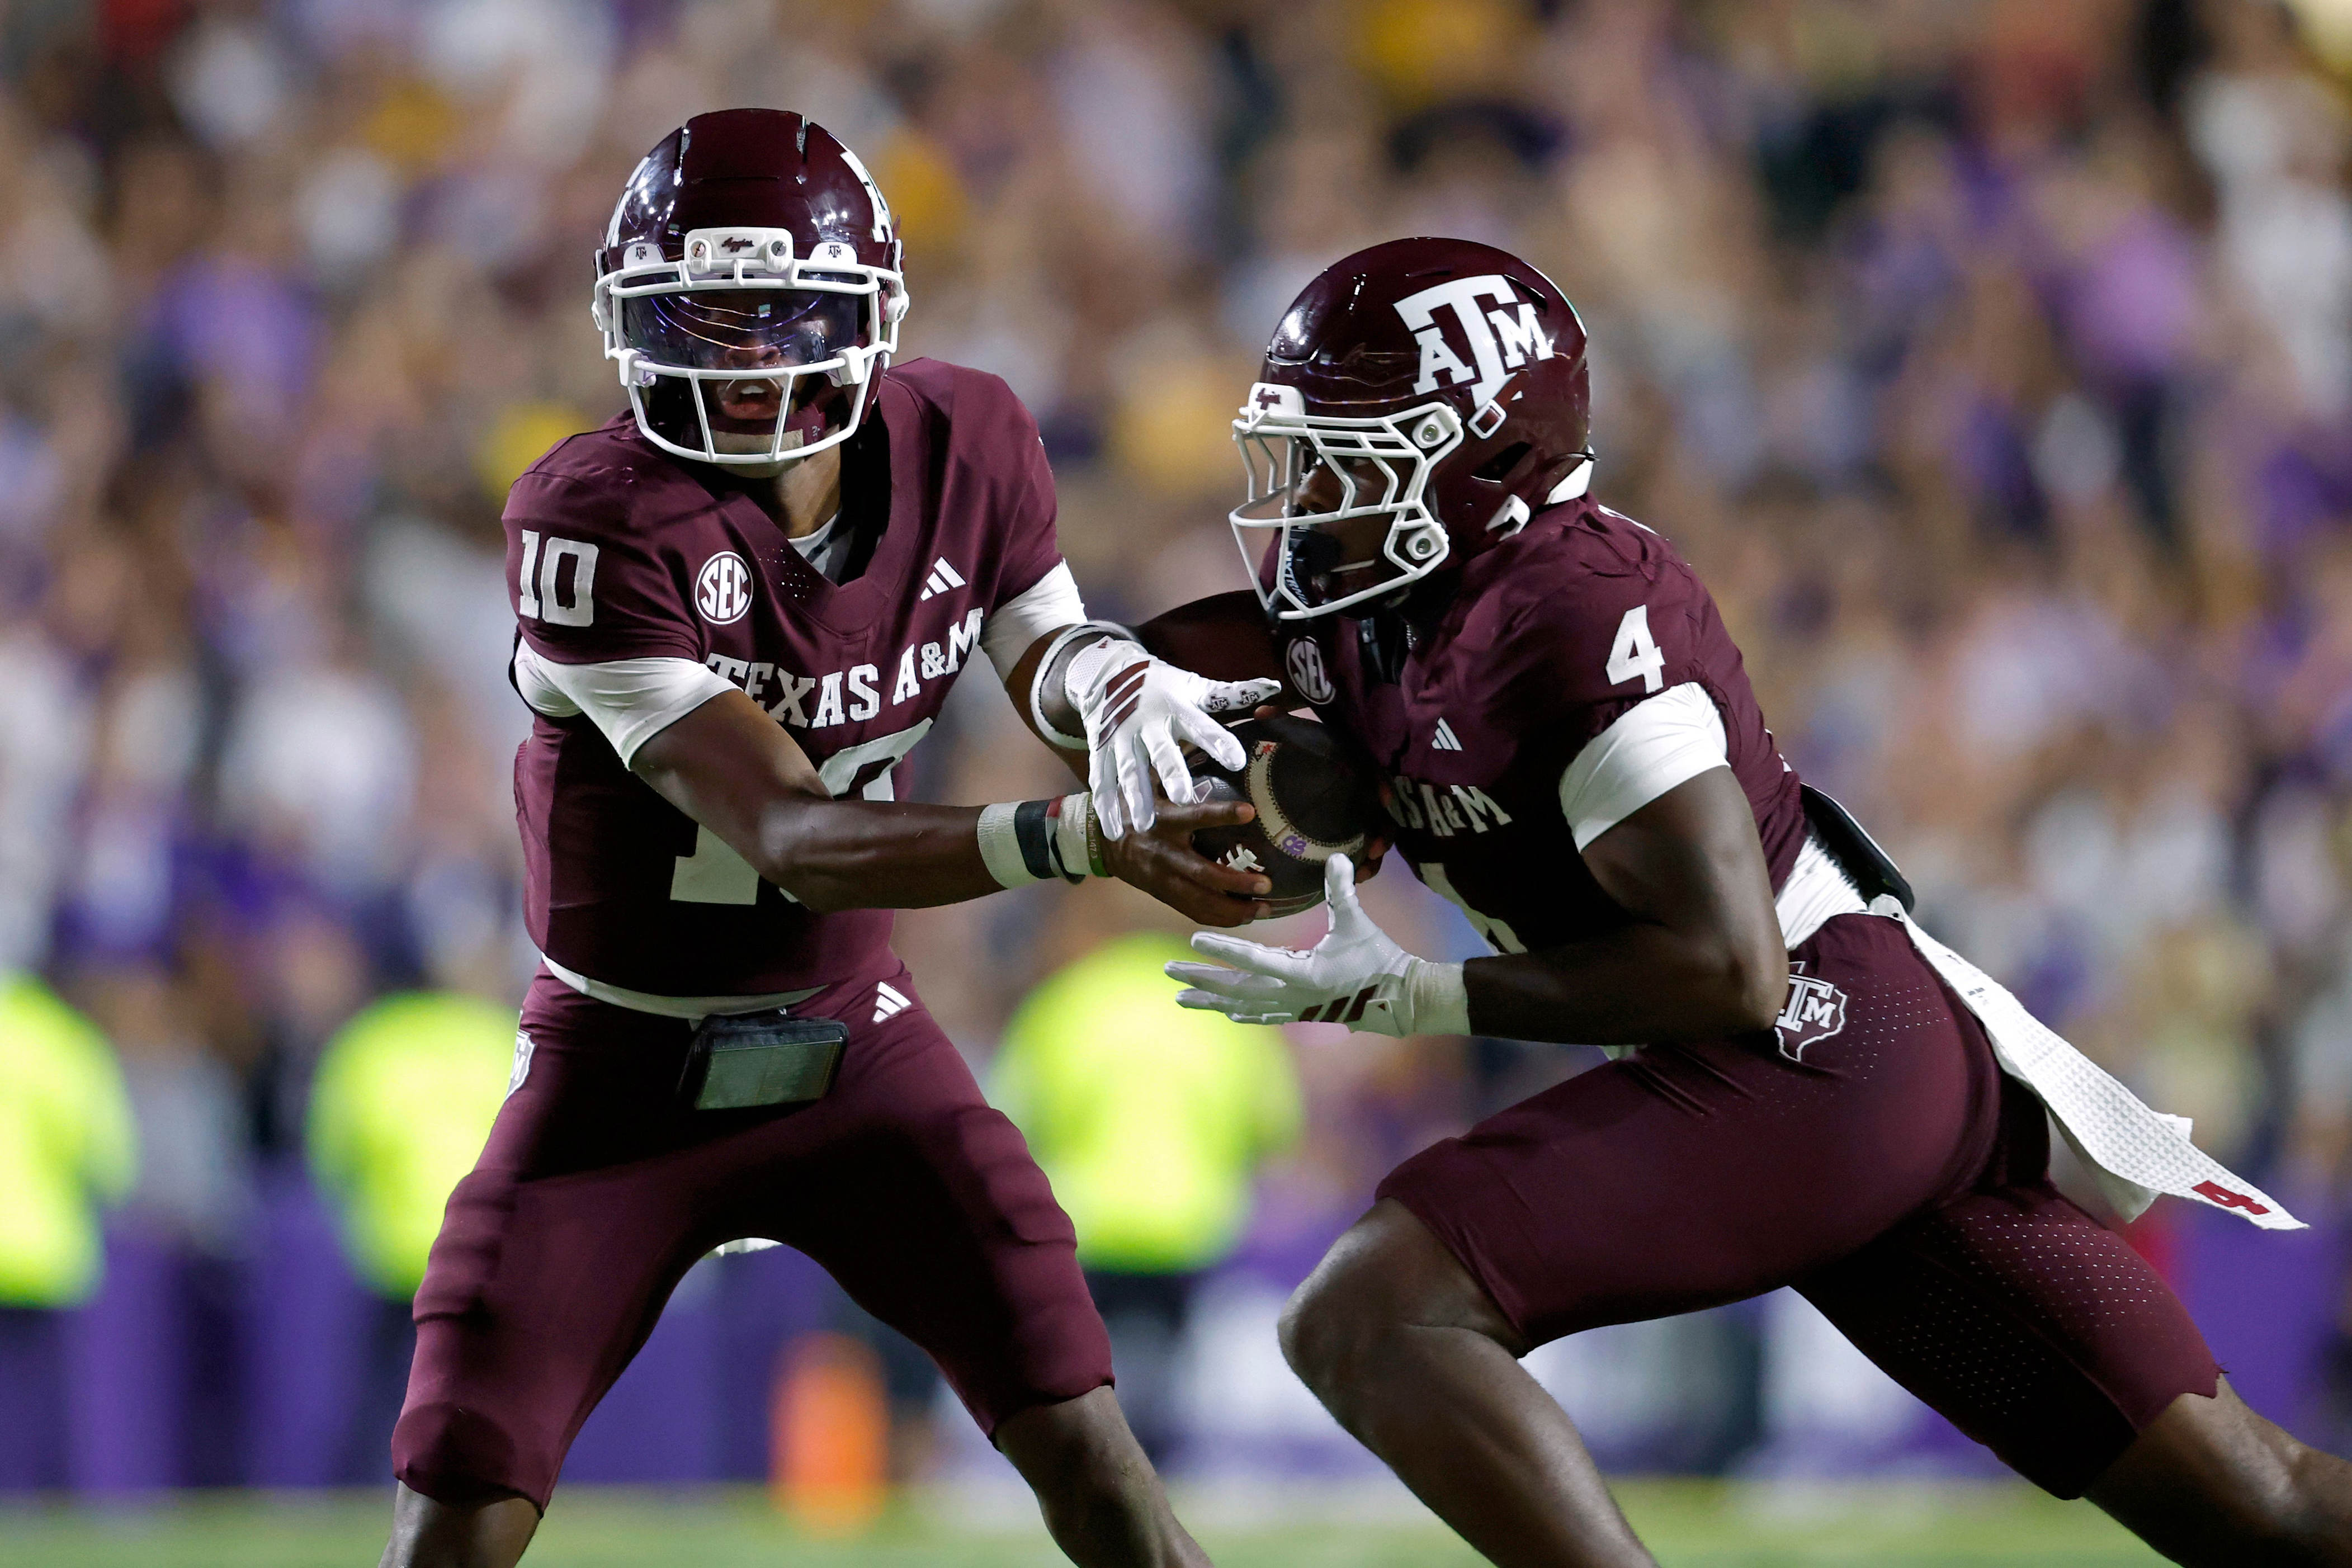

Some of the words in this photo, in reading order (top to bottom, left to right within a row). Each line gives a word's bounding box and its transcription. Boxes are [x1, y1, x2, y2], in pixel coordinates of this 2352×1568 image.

[519, 528, 599, 627] 10
[700, 557, 748, 618] SEC
[705, 652, 880, 729] TEXAS
[892, 607, 984, 706] A&M
[1605, 604, 1666, 695] 4
[1418, 784, 1513, 837] A&M
[2191, 1180, 2271, 1215] 4
